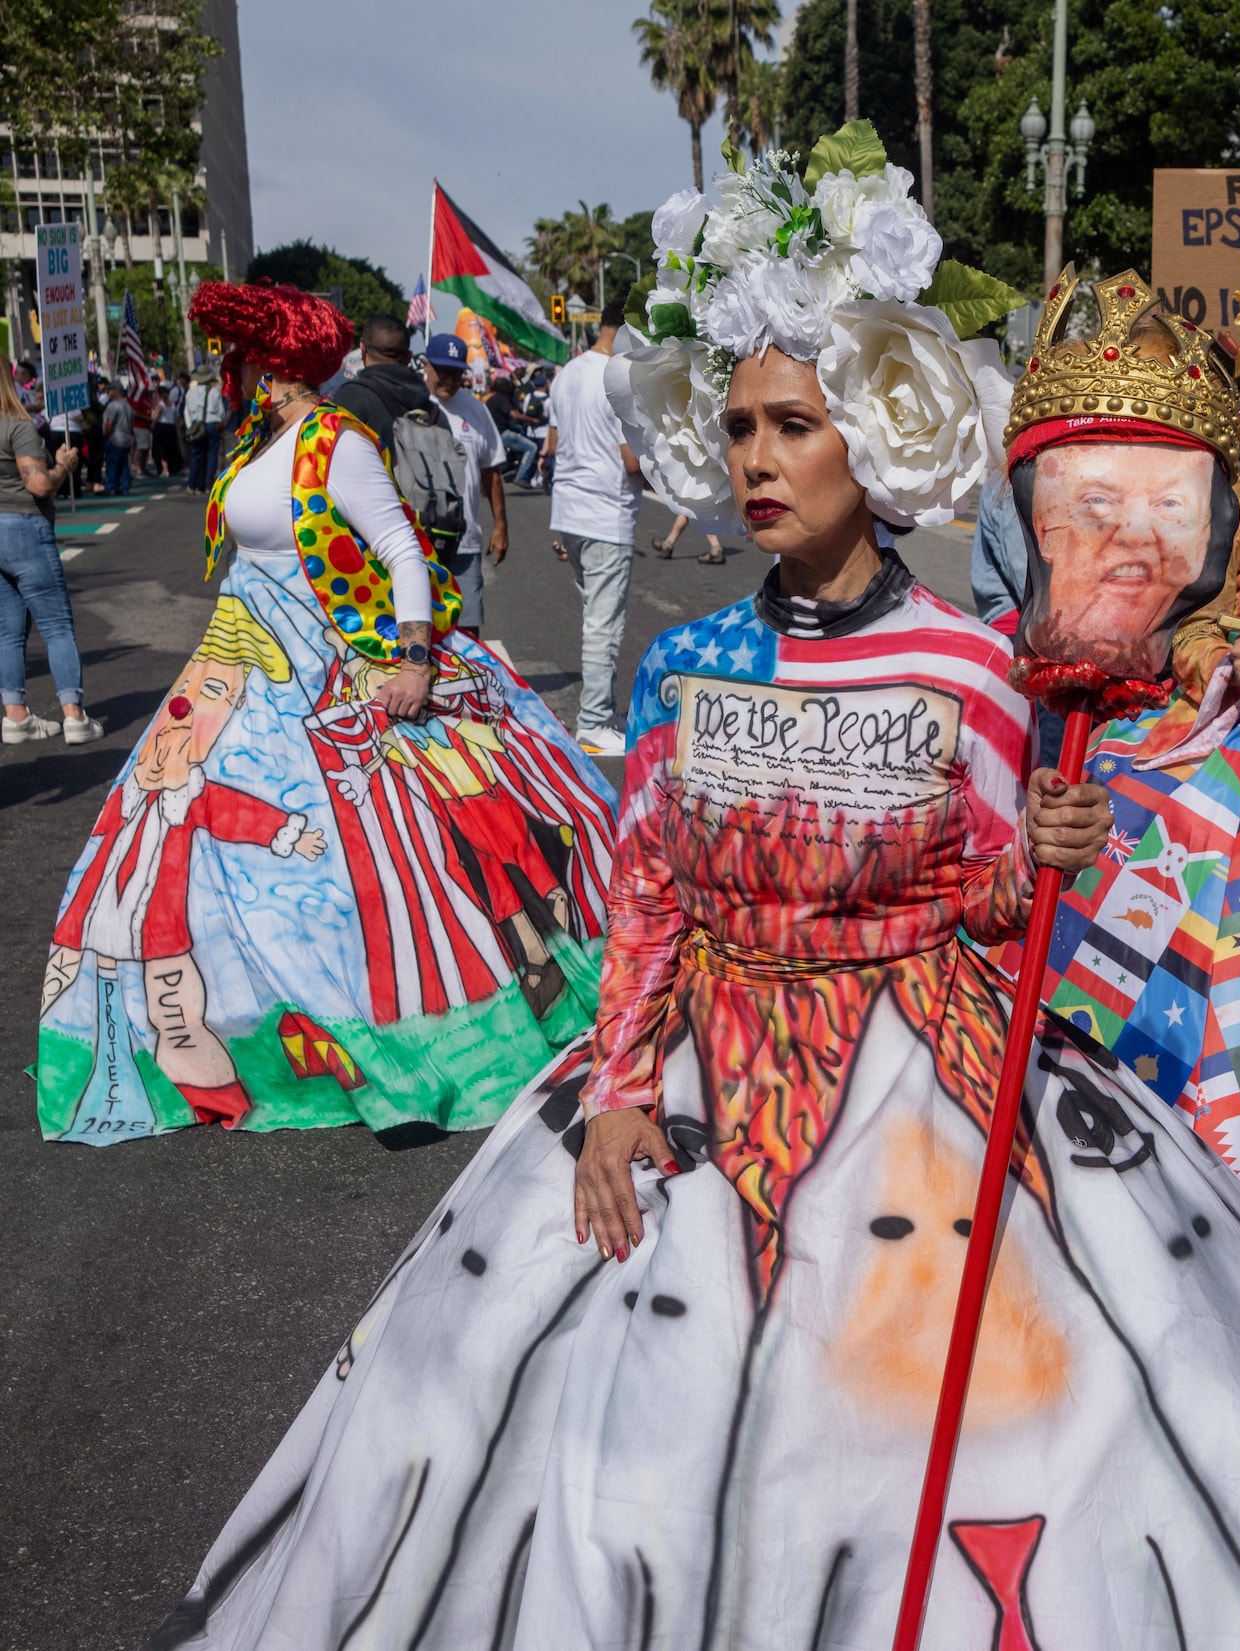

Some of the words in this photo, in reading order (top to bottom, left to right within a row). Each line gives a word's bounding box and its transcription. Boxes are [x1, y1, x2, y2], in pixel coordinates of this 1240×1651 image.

[37, 227, 47, 247] NO
[50, 226, 67, 246] SIGN
[69, 226, 77, 244] IS
[48, 248, 69, 276] BIG
[45, 284, 76, 304] ENOUGH
[1157, 286, 1207, 326] NO
[41, 312, 51, 330] TO
[53, 309, 68, 328] LIST
[69, 307, 84, 325] ALL
[50, 338, 59, 354] OF
[63, 333, 78, 351] THE
[48, 357, 83, 381] REASONS
[60, 381, 91, 412] HERE!
[1066, 416, 1094, 428] Take
[694, 689, 741, 745] We
[800, 696, 943, 766] People
[154, 969, 197, 1050] PUTIN
[105, 982, 122, 1116] PROJECT
[78, 1116, 147, 1136] 2025
